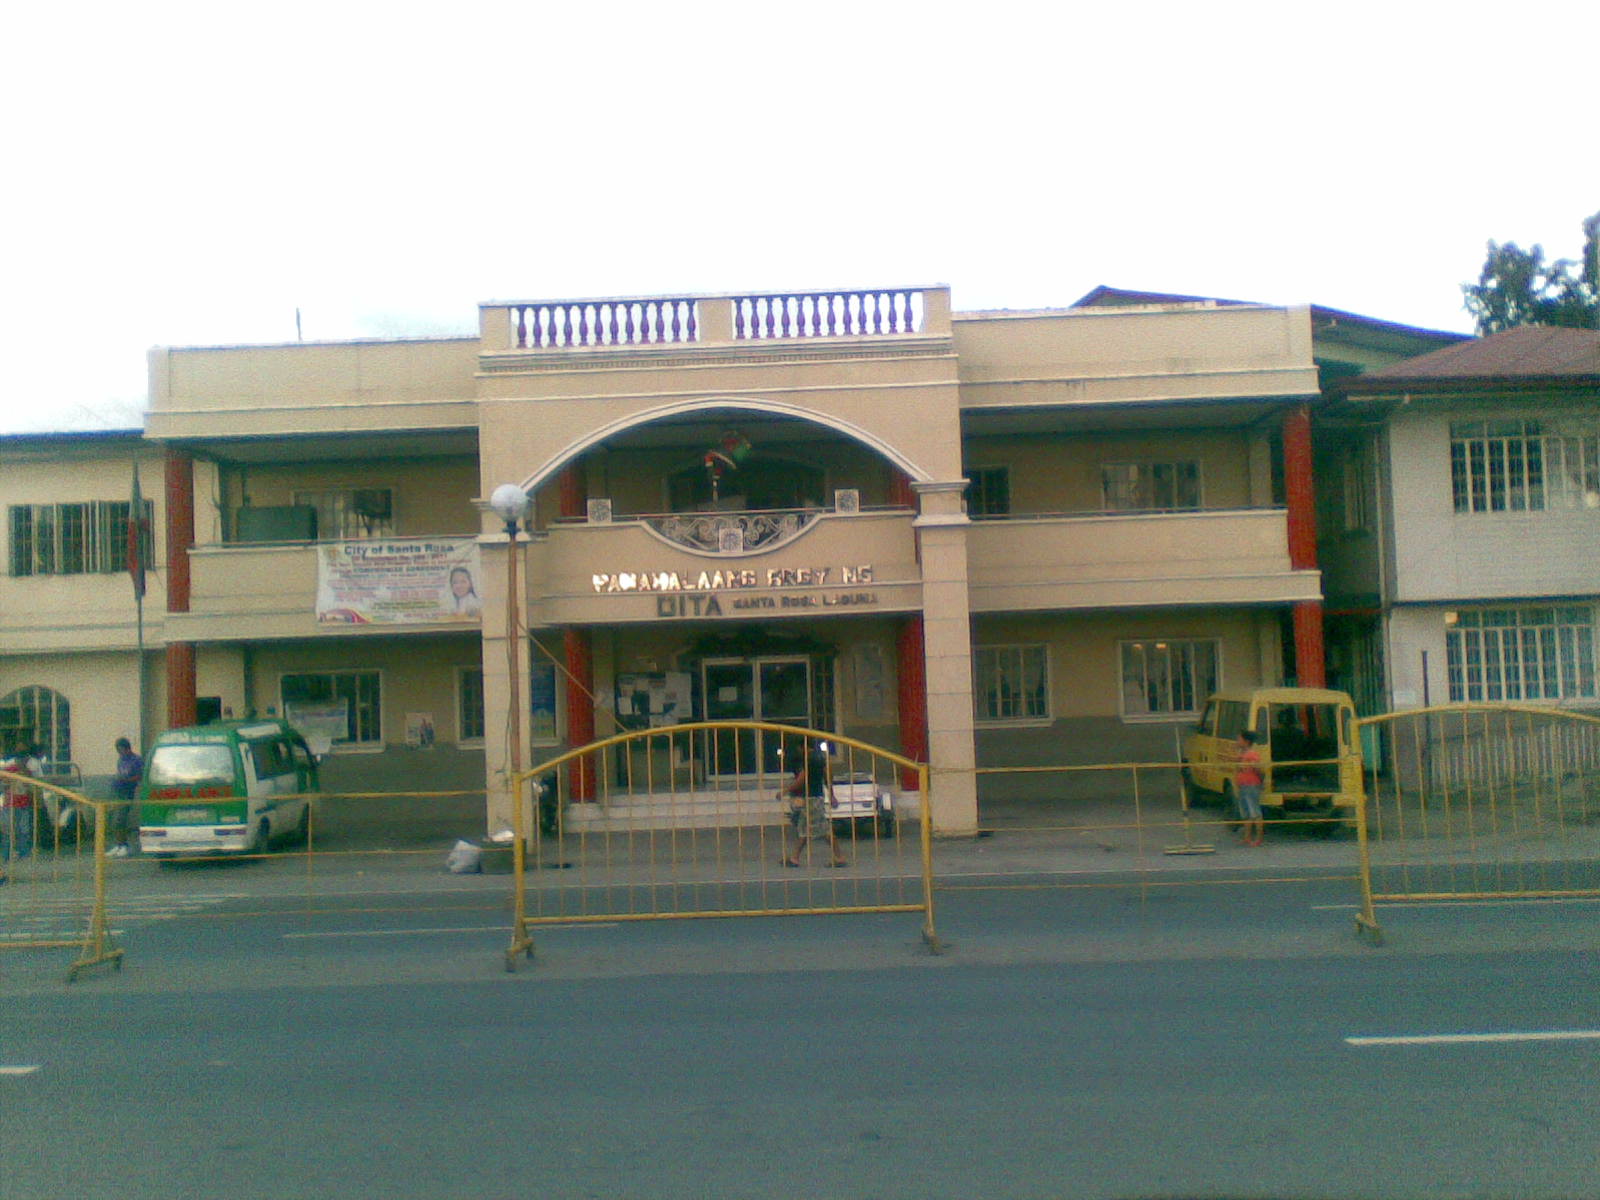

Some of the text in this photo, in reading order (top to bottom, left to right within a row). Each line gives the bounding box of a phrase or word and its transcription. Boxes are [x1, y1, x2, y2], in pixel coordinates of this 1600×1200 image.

[344, 545, 367, 560] City
[371, 545, 382, 554] of
[387, 543, 421, 554] Santa
[766, 566, 831, 587] BRGY
[841, 564, 872, 585] NG
[656, 593, 722, 617] DITA
[733, 596, 776, 609] SANTA
[780, 594, 818, 608] ROSA
